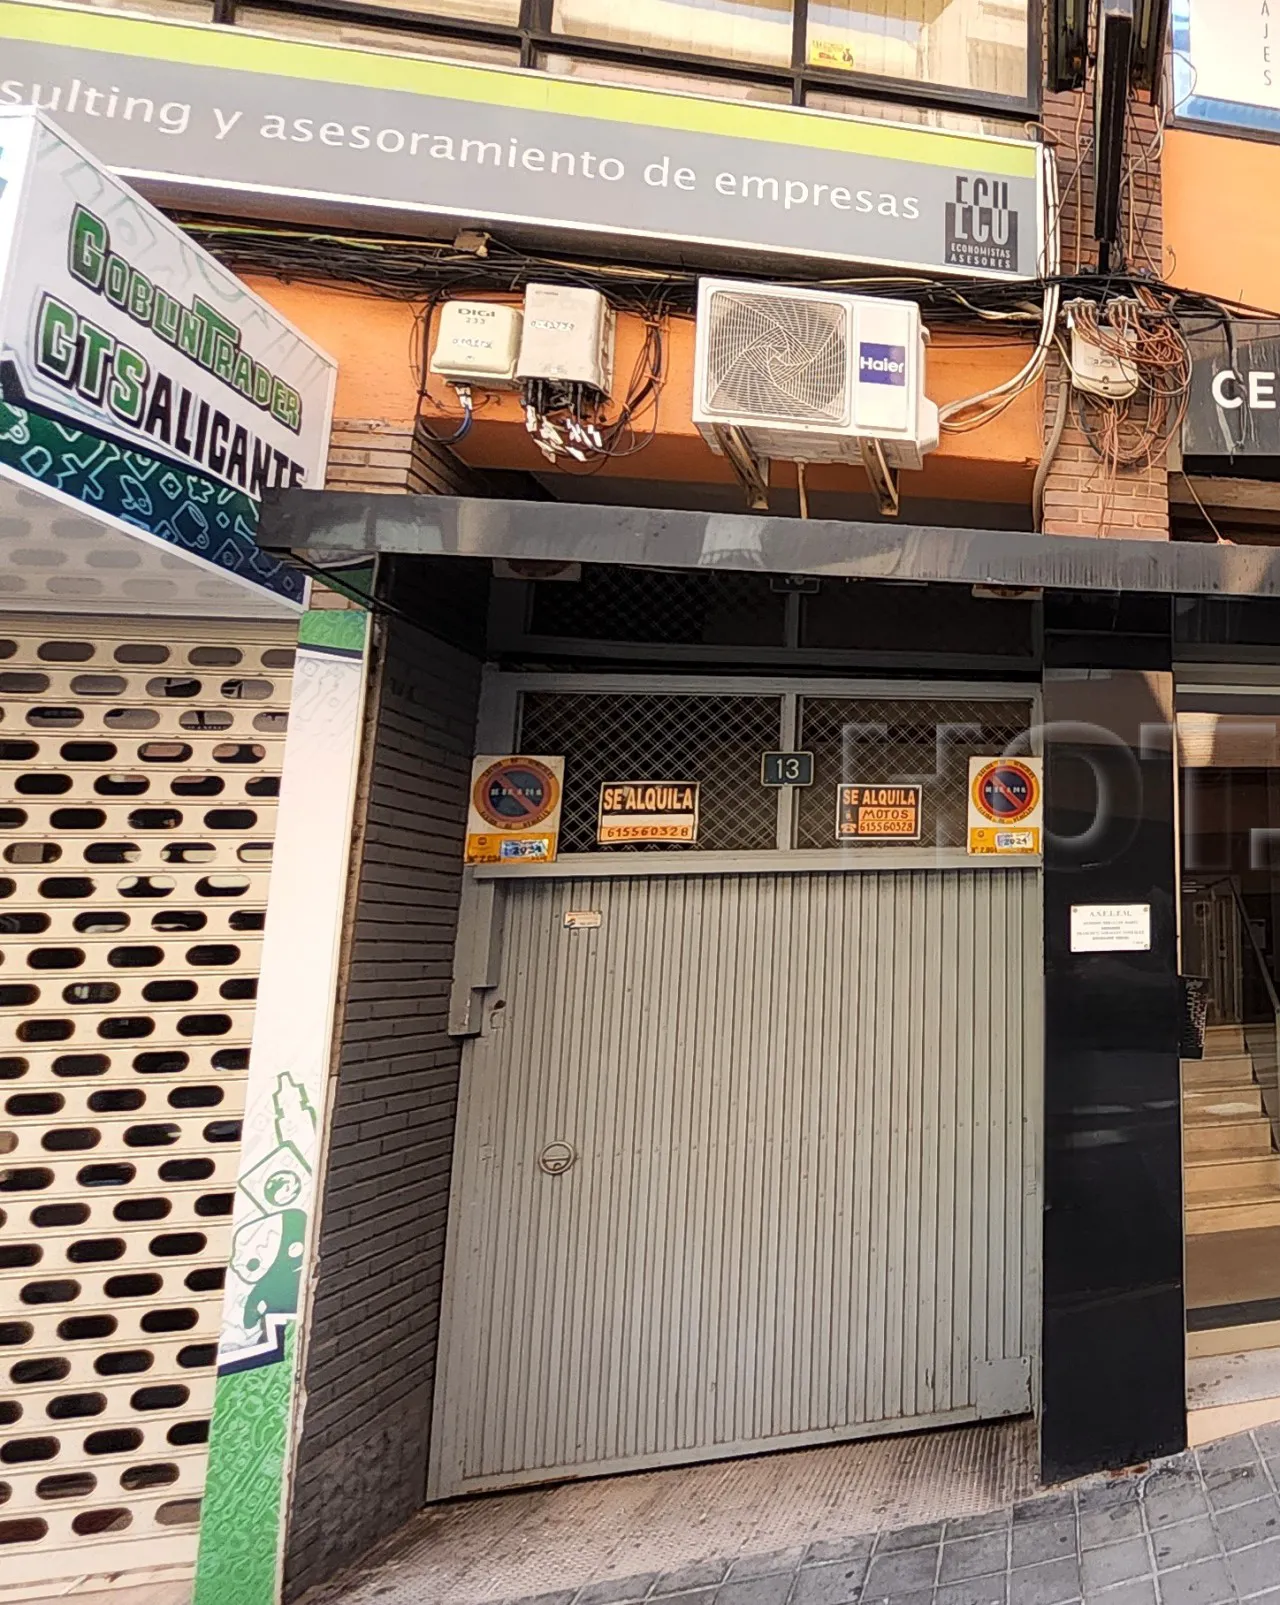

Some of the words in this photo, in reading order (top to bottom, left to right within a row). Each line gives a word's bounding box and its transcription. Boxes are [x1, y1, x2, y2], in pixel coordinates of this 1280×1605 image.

[213, 106, 244, 139] y
[259, 115, 626, 182] asesoramiento
[644, 156, 697, 191] de
[714, 170, 920, 220] empresas
[950, 242, 1011, 259] ECONOMISTAS
[950, 253, 1011, 269] ASESORES
[860, 356, 905, 374] Haier
[776, 758, 800, 780] 13
[603, 788, 624, 810] SE
[625, 787, 694, 811] ALQUILA
[842, 788, 860, 805] SE
[862, 788, 916, 806] ALQUILA
[862, 809, 909, 820] MOTOS
[607, 826, 689, 838] 615560328
